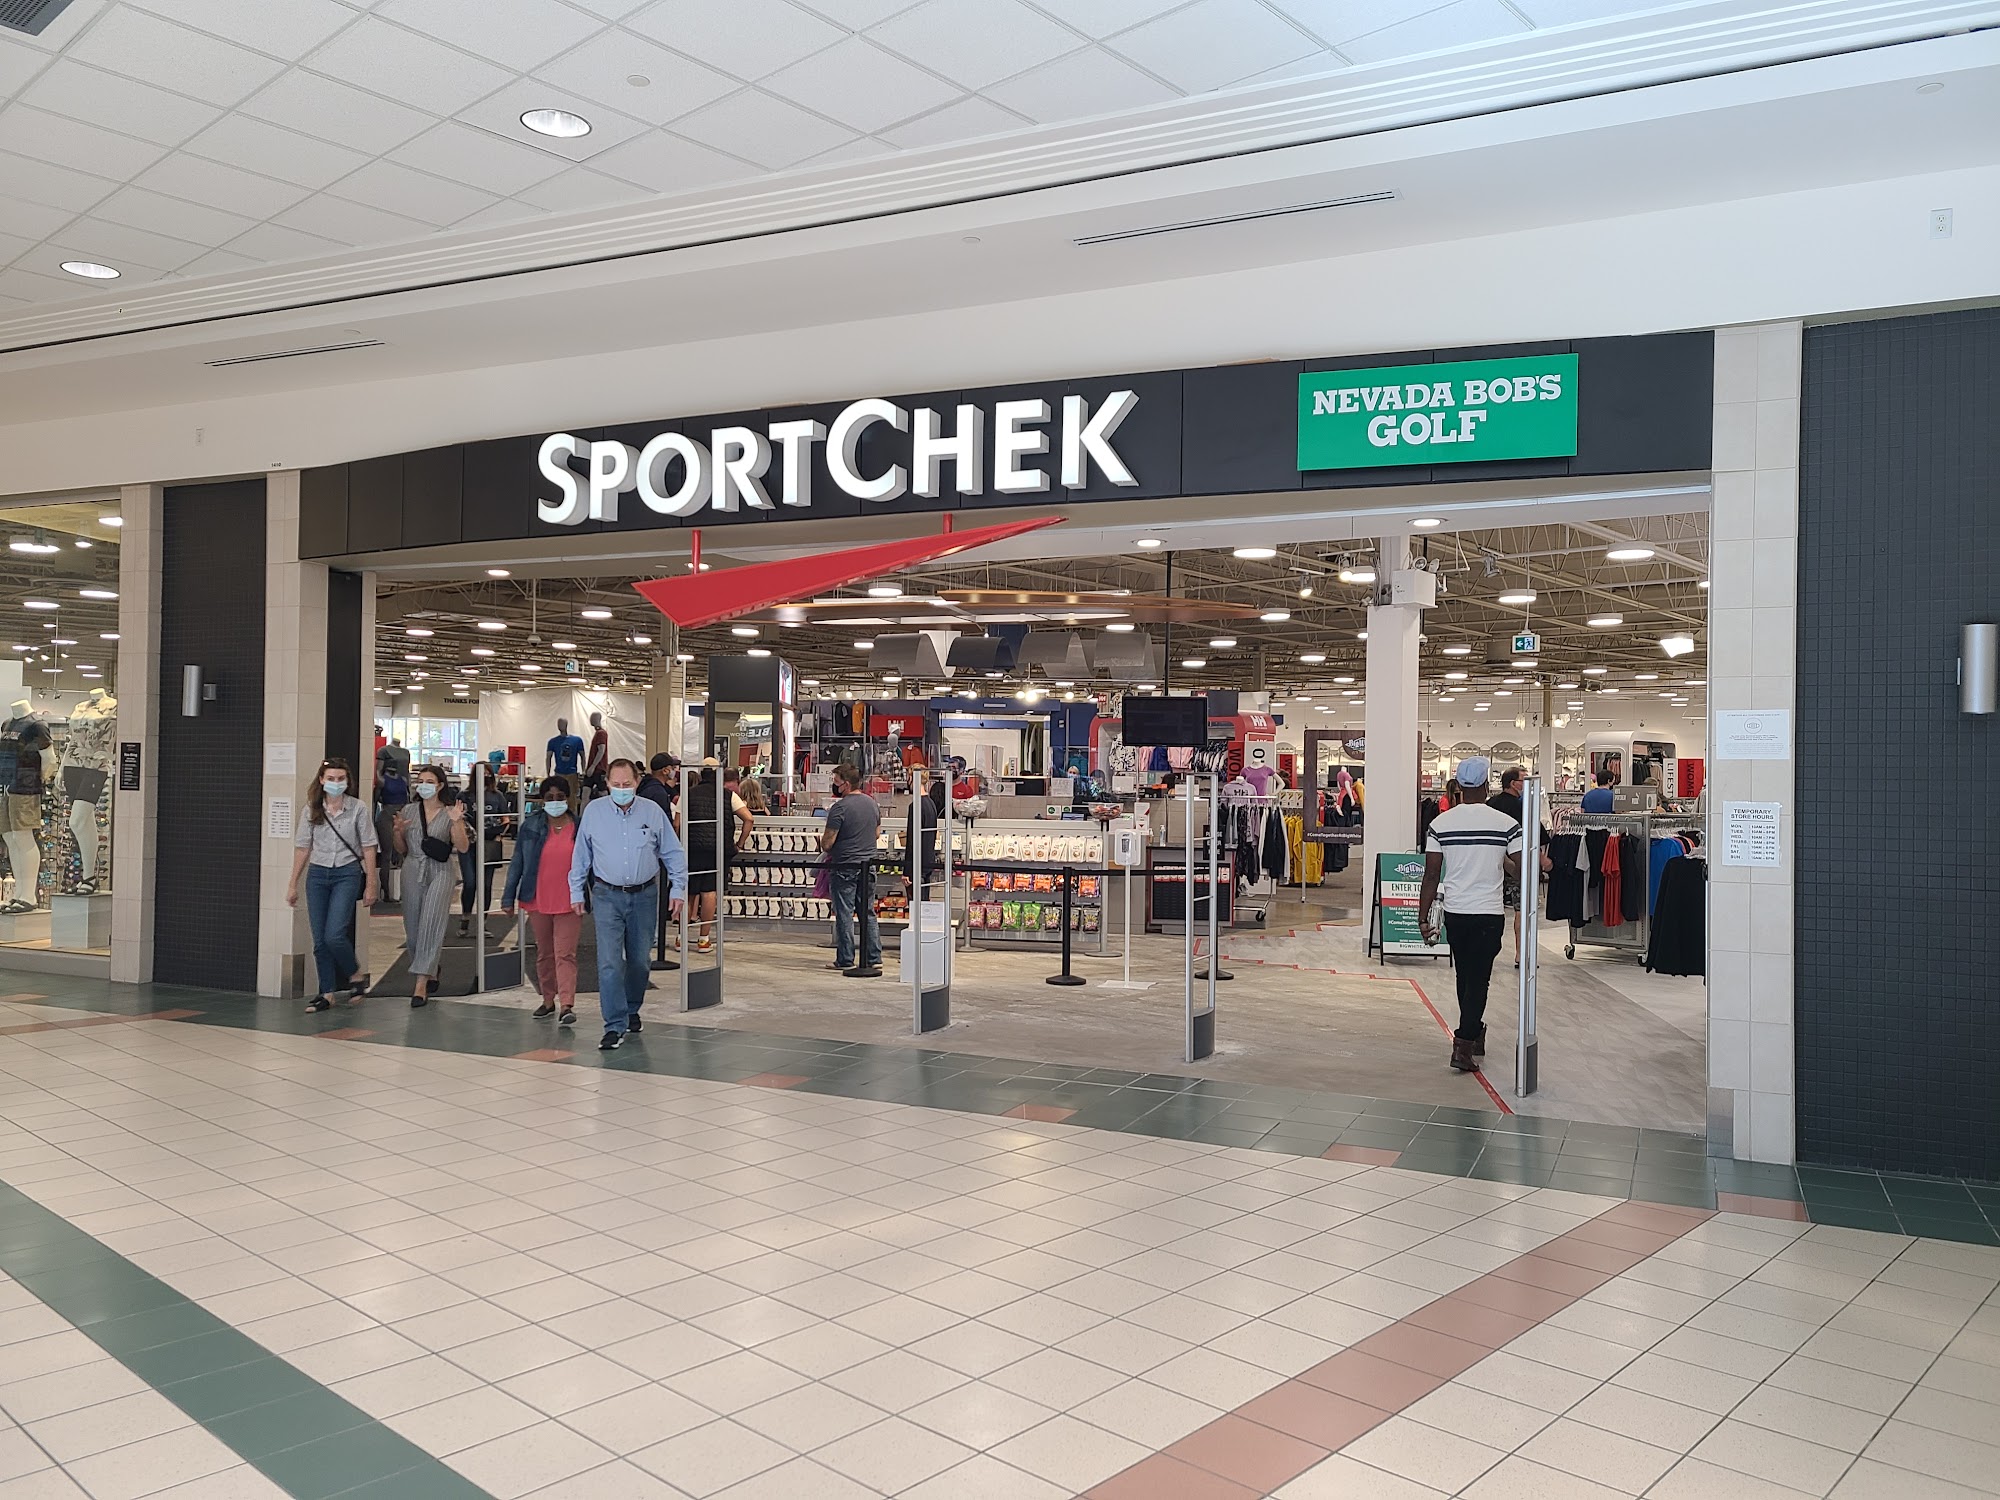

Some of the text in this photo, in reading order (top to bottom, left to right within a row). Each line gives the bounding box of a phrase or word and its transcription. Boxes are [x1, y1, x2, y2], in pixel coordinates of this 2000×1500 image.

[1312, 374, 1562, 415] NEVADA BOB'S
[1367, 409, 1487, 447] GOLF
[537, 390, 1139, 526] SPORTCHEK
[1391, 883, 1413, 891] ENTER
